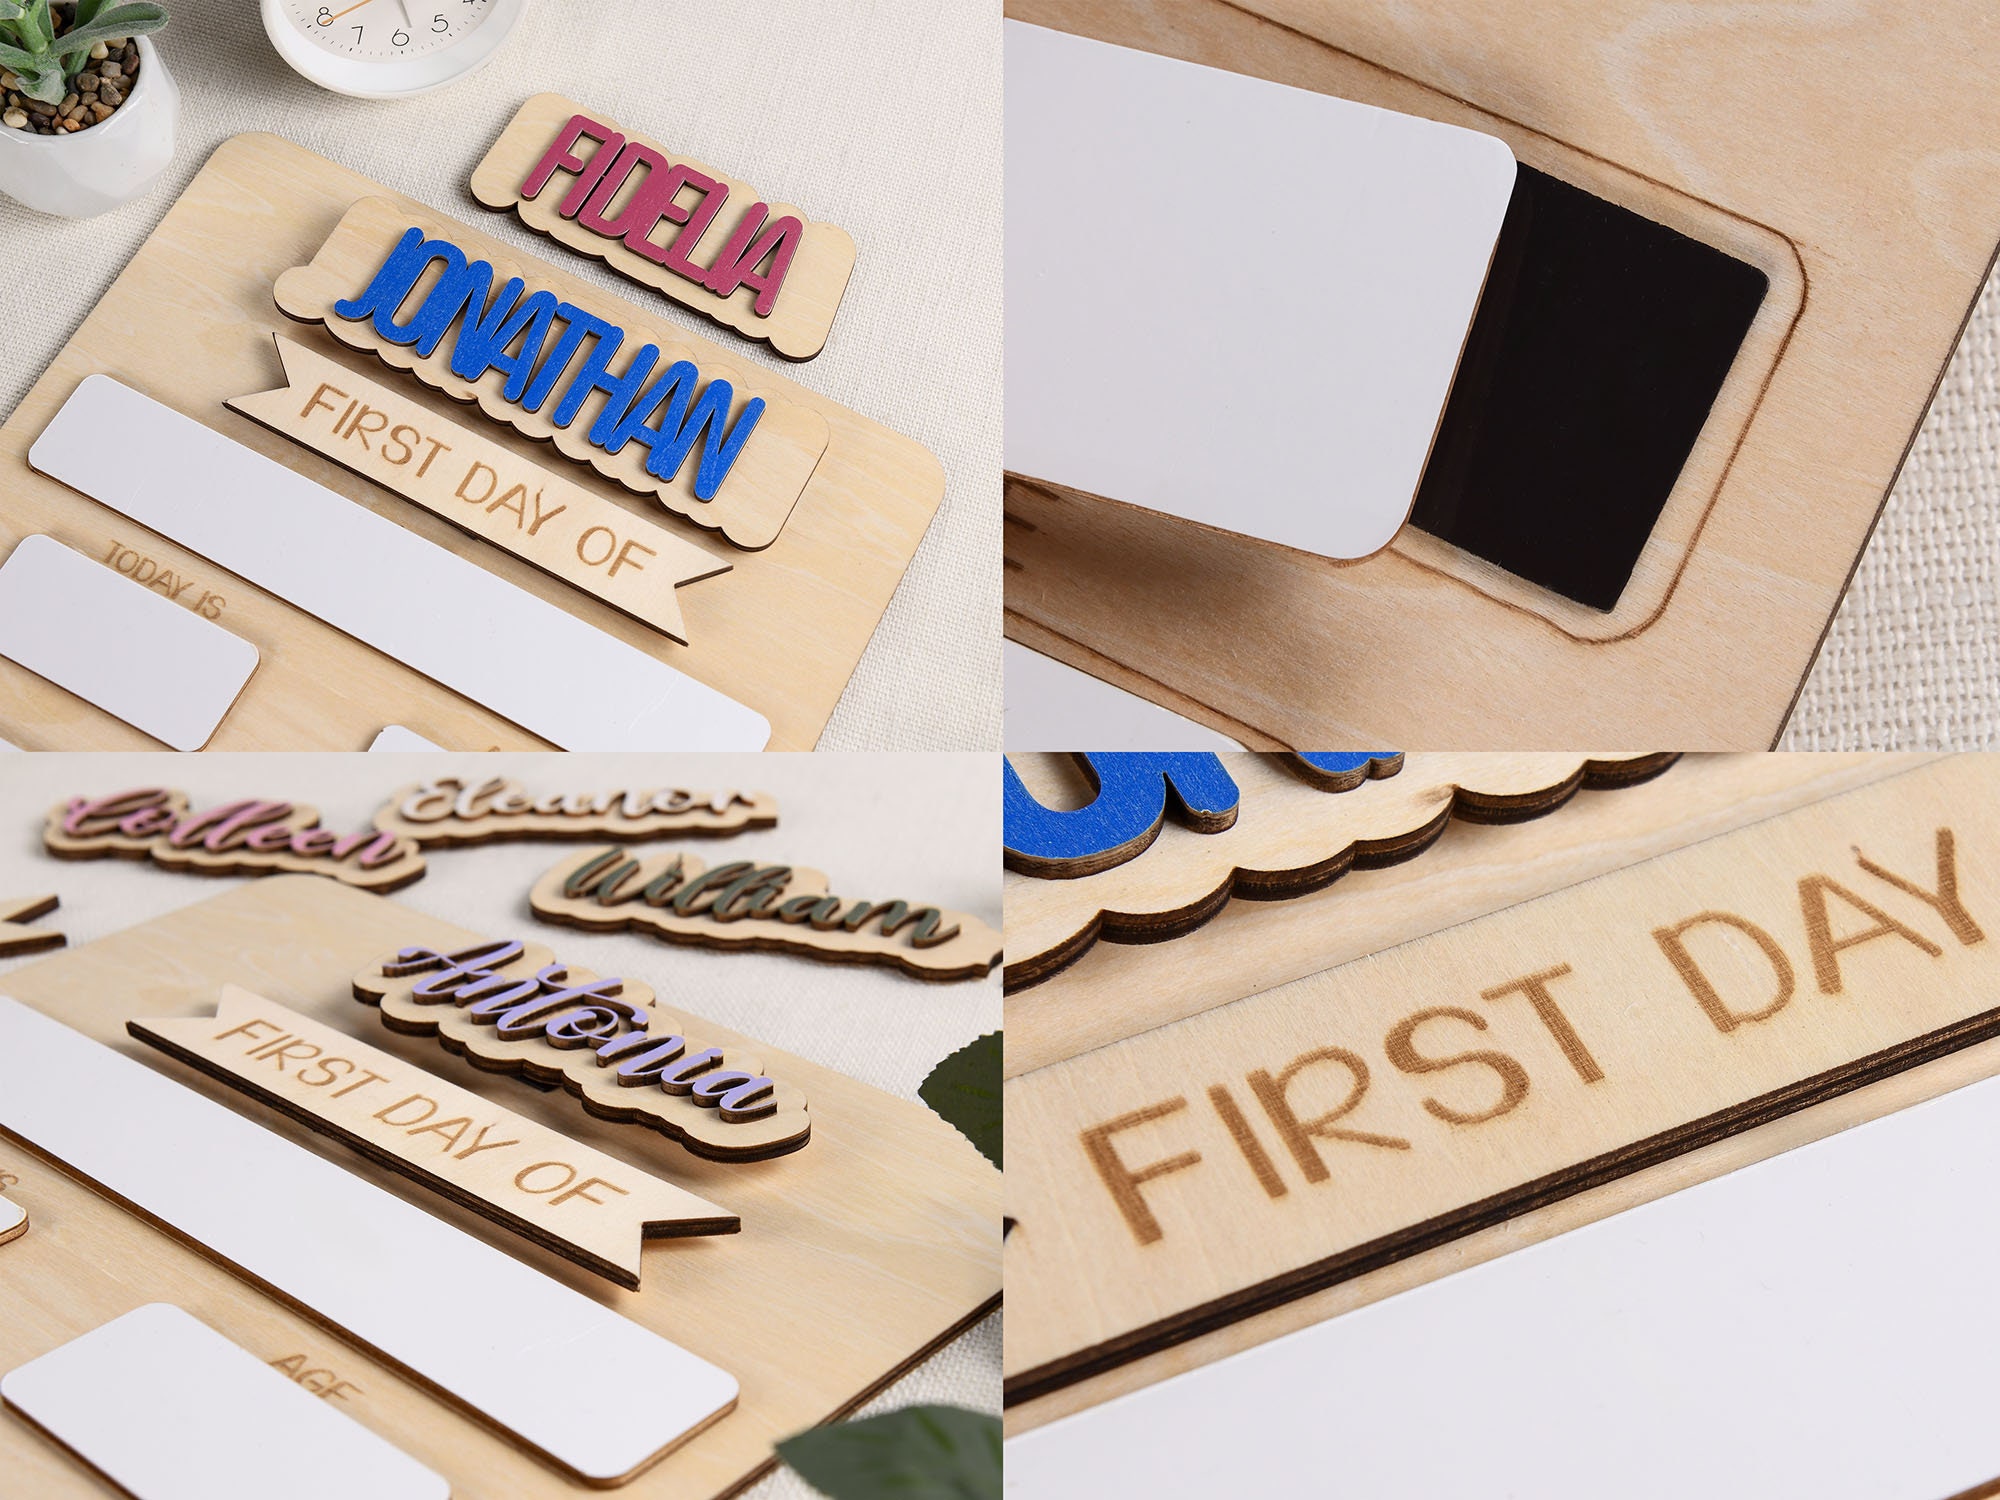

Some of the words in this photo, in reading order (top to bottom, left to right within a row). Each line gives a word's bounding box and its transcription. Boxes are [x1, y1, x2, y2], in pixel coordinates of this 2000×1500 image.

[316, 6, 335, 27] 8
[351, 25, 364, 45] 7
[391, 28, 410, 47] 6
[431, 14, 449, 33] 5
[520, 114, 803, 317] FIDELIA
[334, 226, 767, 503] JONATHAN
[300, 382, 452, 479] FIRST
[455, 462, 567, 538] DAY
[576, 526, 658, 579] OF
[105, 540, 195, 600] TODAY
[194, 591, 227, 620] IS
[63, 786, 402, 866] Colleen
[402, 777, 754, 823] Eleanor
[563, 844, 960, 947] William
[381, 938, 779, 1123] Antonia
[1080, 960, 1607, 1246] FIRST
[1652, 826, 1986, 1034] DAY
[214, 1018, 391, 1099] FIRST
[373, 1094, 518, 1163] DAY
[514, 1160, 631, 1213] OF
